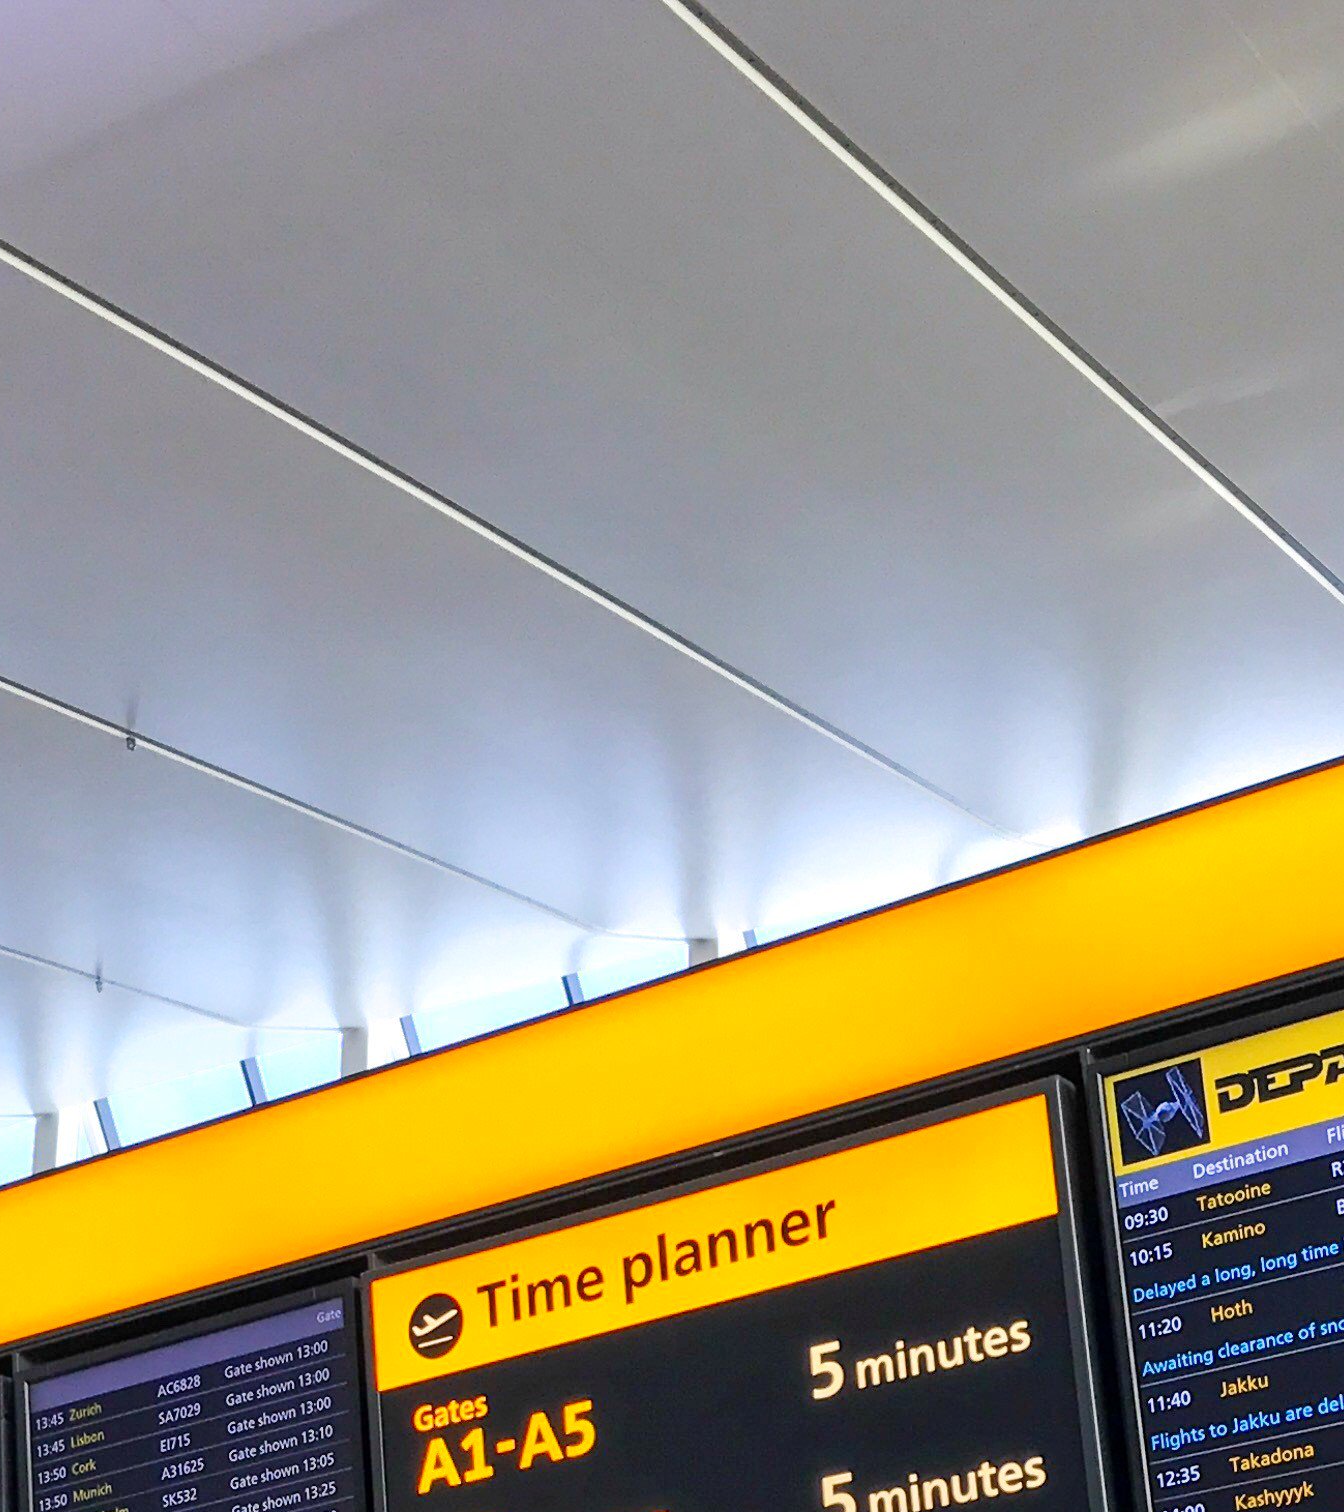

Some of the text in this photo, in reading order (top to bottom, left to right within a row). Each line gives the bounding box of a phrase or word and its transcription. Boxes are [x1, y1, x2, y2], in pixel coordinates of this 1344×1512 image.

[1118, 1178, 1159, 1197] Time
[1192, 1144, 1288, 1179] Destination
[1124, 1206, 1168, 1230] 09:30
[1196, 1183, 1271, 1211] Tatooine
[477, 1197, 836, 1330] Time planner
[1129, 1242, 1172, 1266] 10:15
[1201, 1222, 1265, 1248] Kamino
[1133, 1273, 1197, 1302] Delayed
[1201, 1274, 1211, 1286] a
[1214, 1264, 1256, 1283] long,
[1260, 1253, 1298, 1272] long
[1300, 1243, 1339, 1262] time
[1138, 1316, 1182, 1339] 11:20
[1210, 1299, 1253, 1322] Hoth
[809, 1316, 1032, 1399] 5 minutes
[36, 1412, 64, 1430] 13:45
[157, 1374, 200, 1397] AC6828
[224, 1363, 252, 1378] Gate
[254, 1352, 293, 1370] shown
[297, 1339, 327, 1358] 13:00
[414, 1393, 488, 1433] Gates
[417, 1400, 597, 1494] A1-A5
[1156, 1464, 1200, 1488] 12:35
[1228, 1445, 1314, 1472] Takadona
[1234, 1481, 1314, 1511] Kashyyyk
